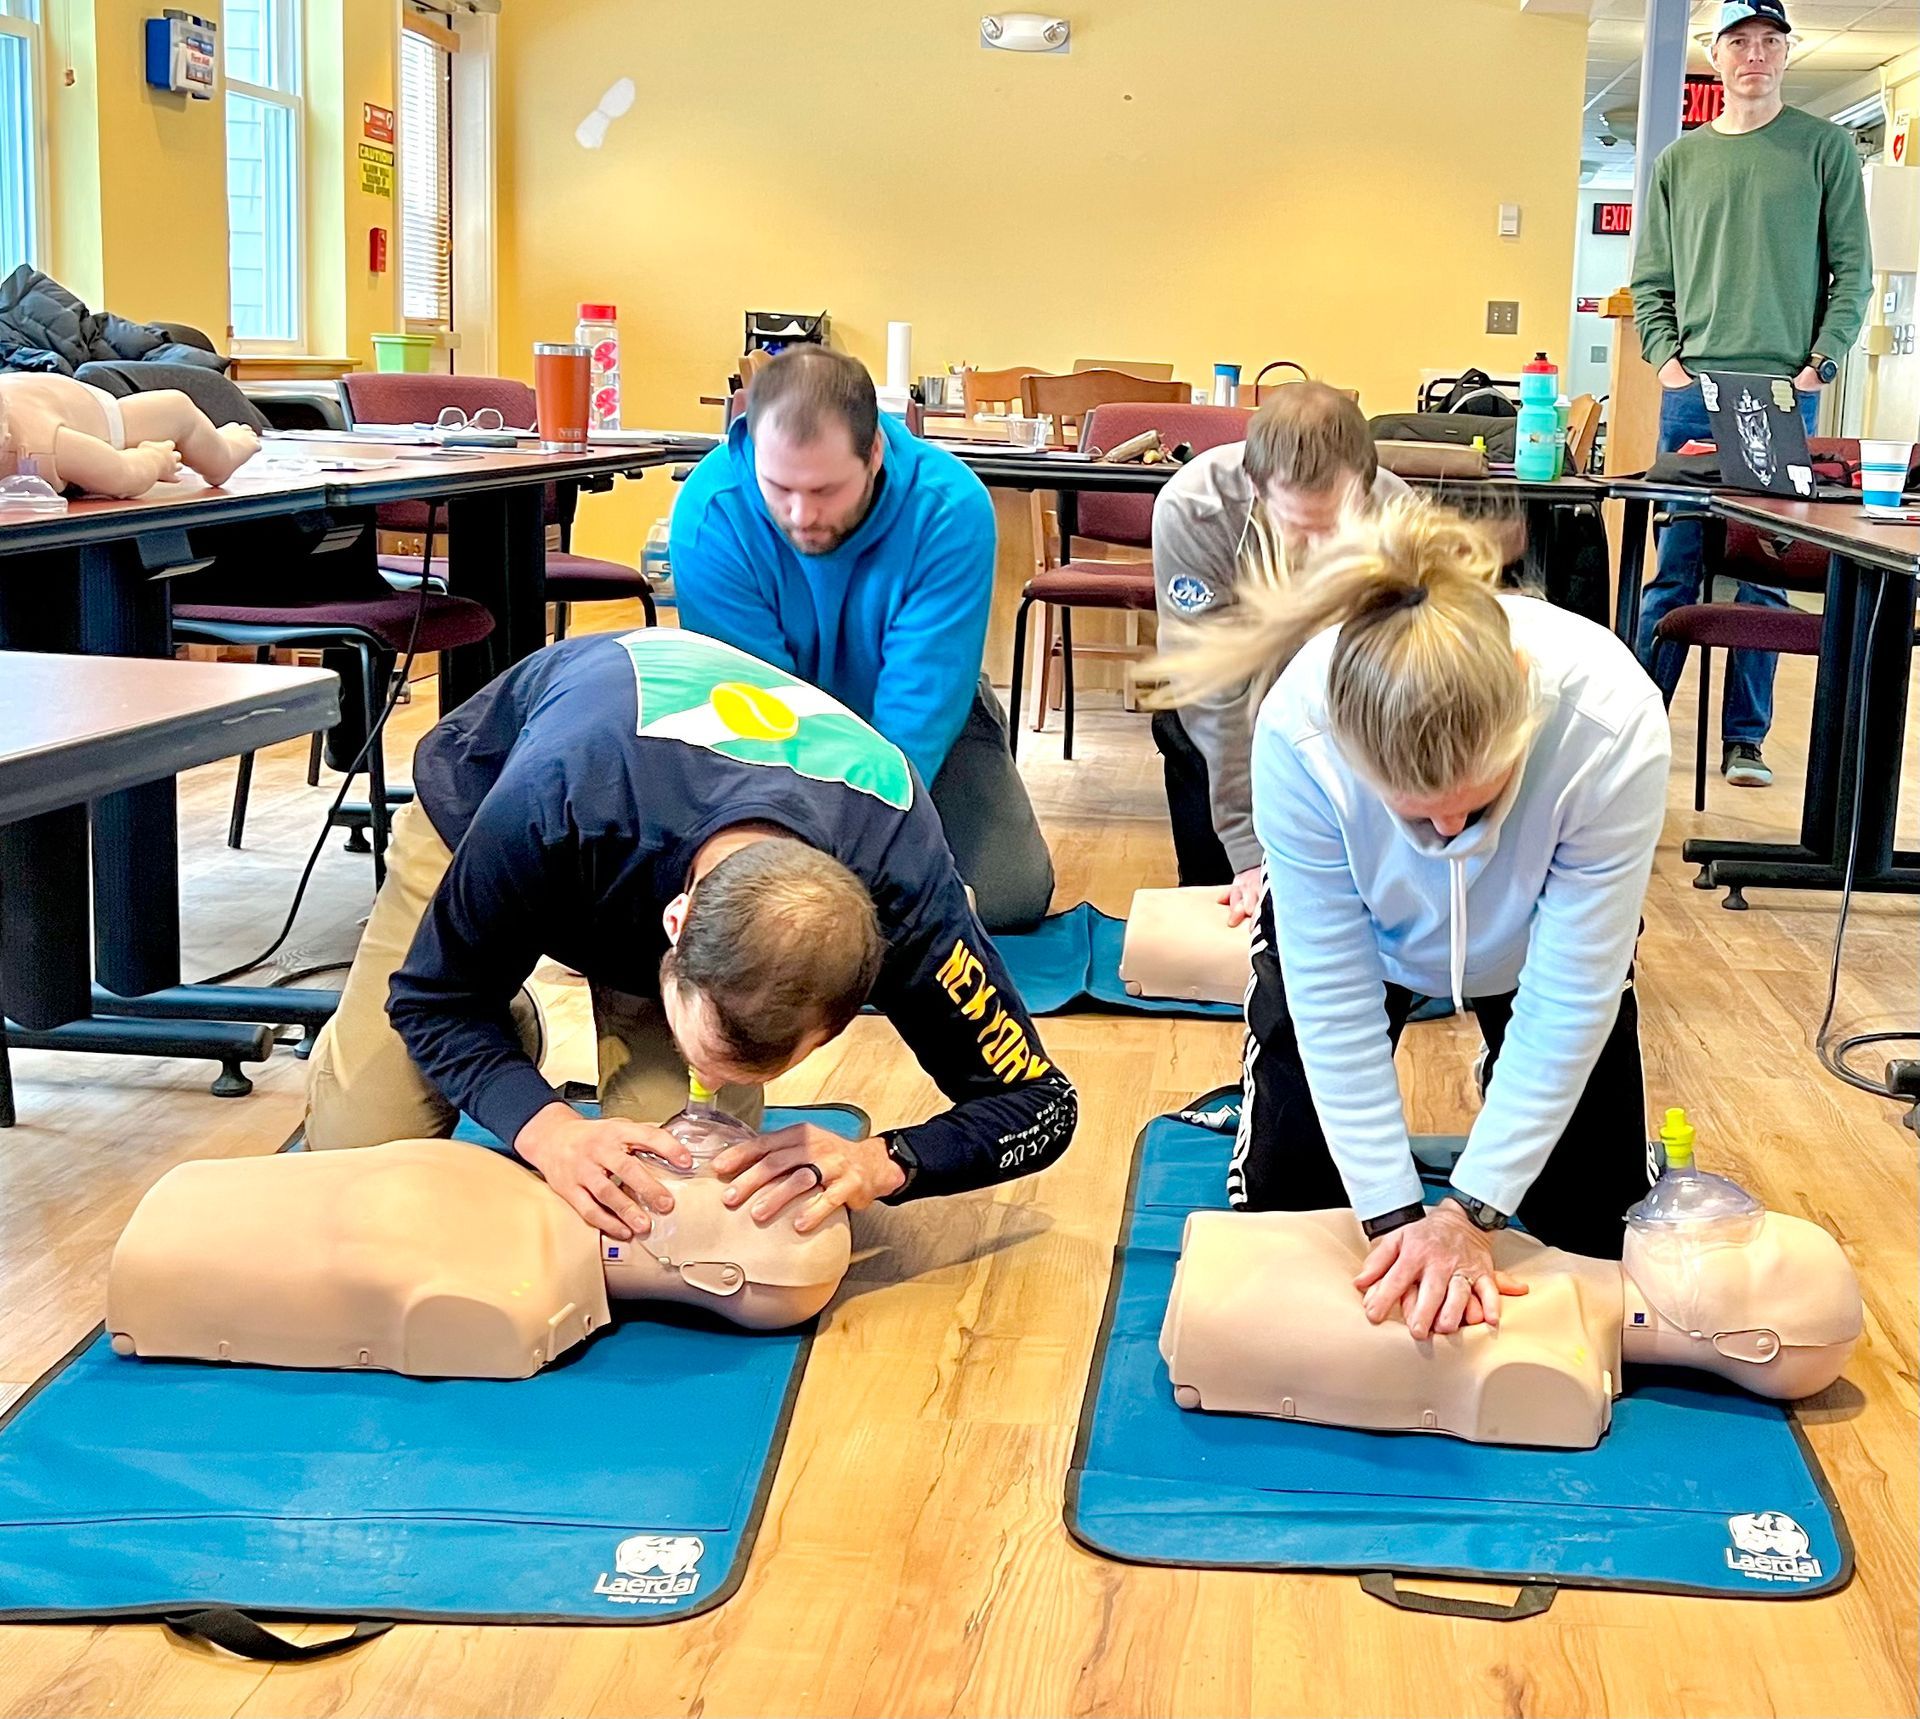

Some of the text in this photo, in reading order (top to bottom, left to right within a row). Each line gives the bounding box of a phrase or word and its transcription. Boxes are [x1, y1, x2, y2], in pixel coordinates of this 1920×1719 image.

[1682, 84, 1723, 121] EXIT
[360, 145, 393, 165] CAUTION
[1602, 205, 1632, 231] EXIT
[936, 939, 997, 1021] NEW
[1724, 1548, 1822, 1577] Laerdal
[594, 1572, 701, 1597] Laerdal
